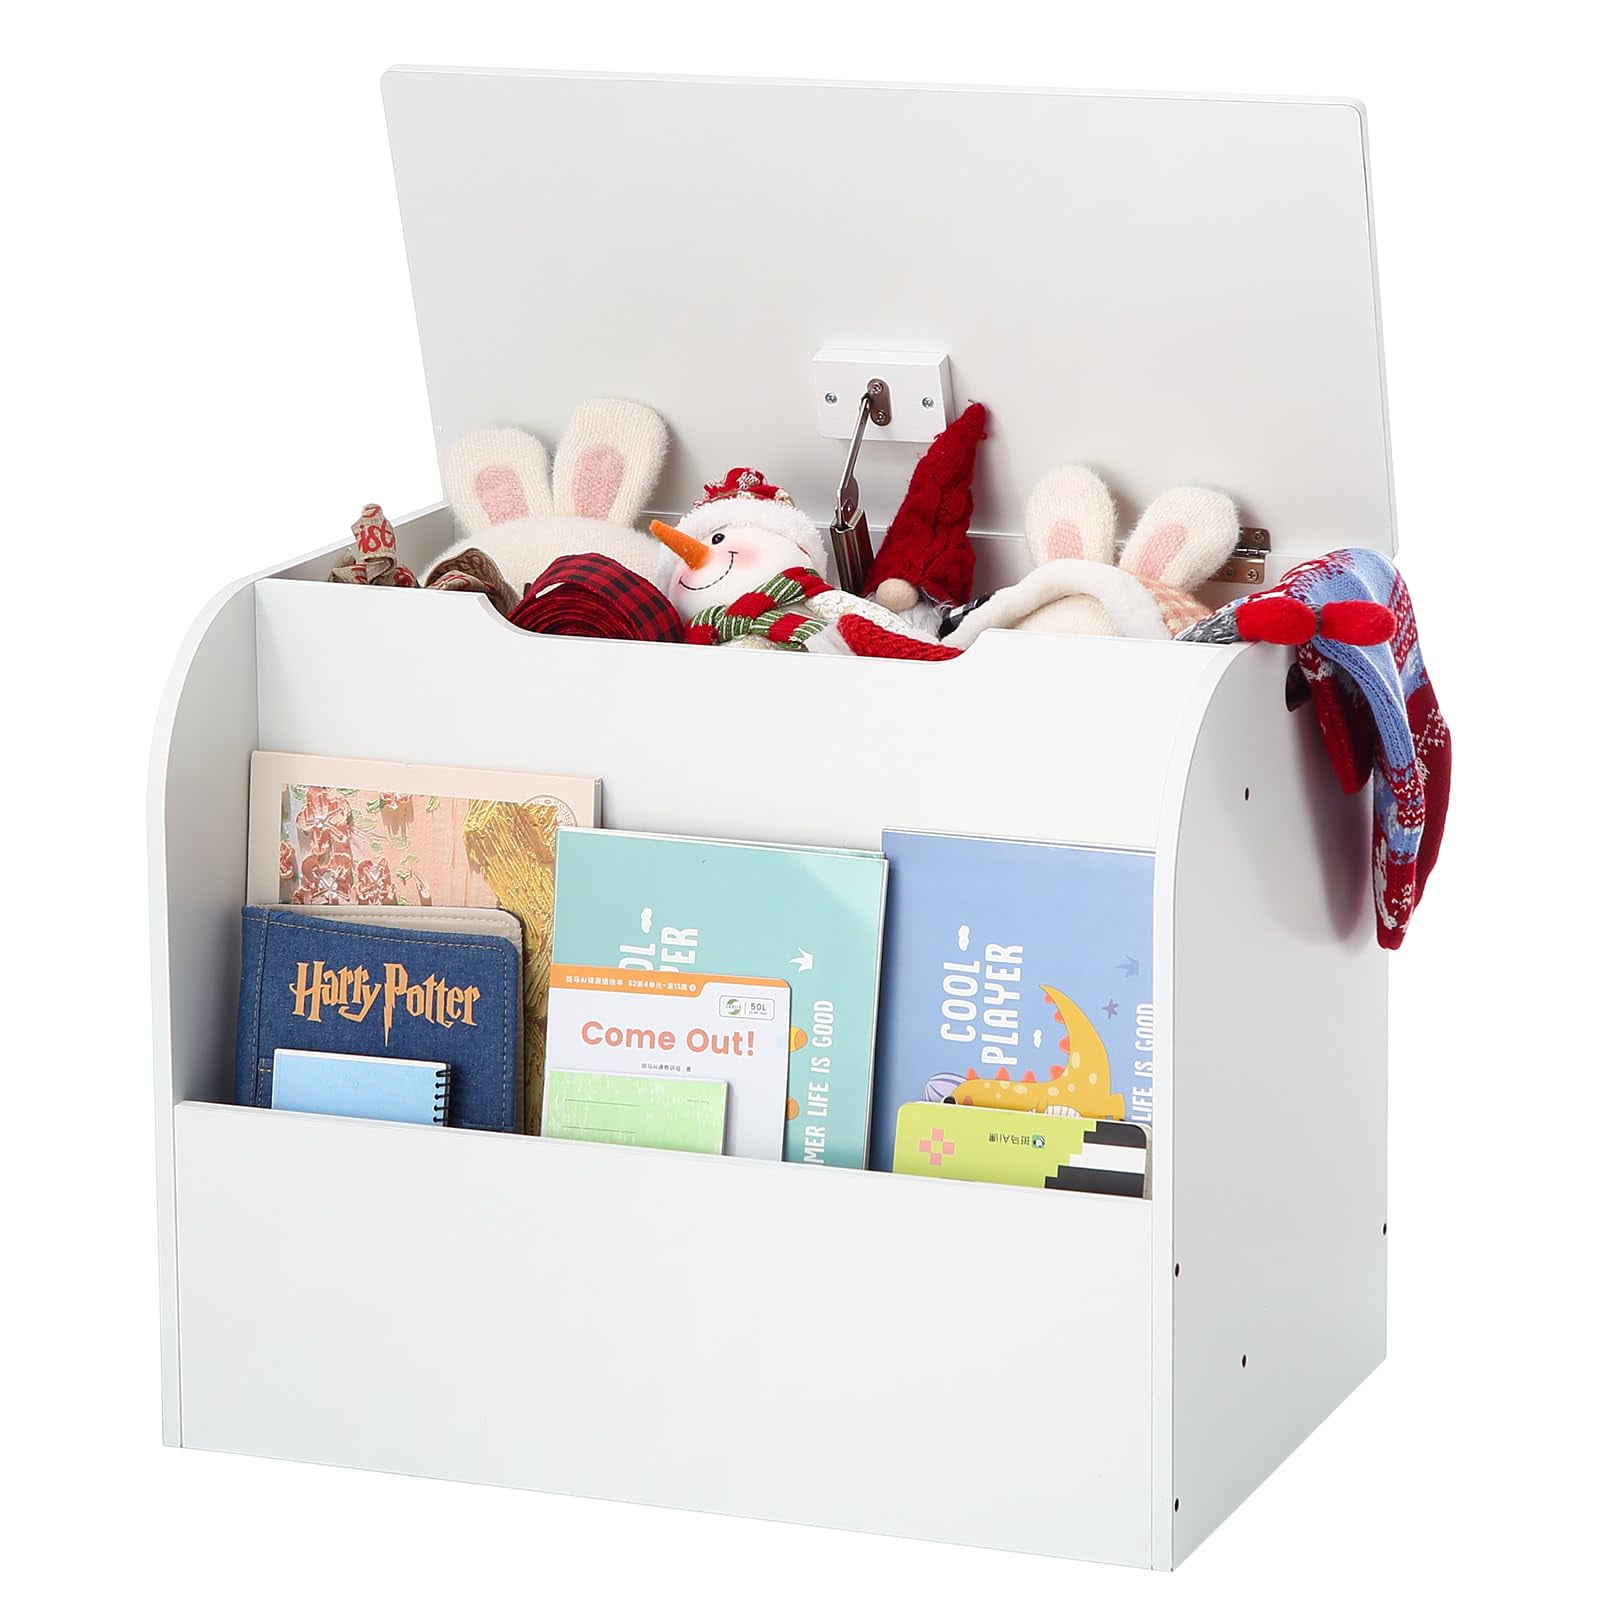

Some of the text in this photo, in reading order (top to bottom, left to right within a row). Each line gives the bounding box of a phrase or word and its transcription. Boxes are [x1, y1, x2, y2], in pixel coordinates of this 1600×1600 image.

[289, 960, 481, 1047] Harry Potter
[812, 1000, 834, 1048] GOOD
[940, 960, 980, 1042] COOL
[981, 943, 1023, 1065] PLAYER
[581, 1020, 754, 1057] Come Out!
[810, 1056, 831, 1073] IS
[1131, 1003, 1153, 1122] LIFE IS GOOD
[807, 1082, 829, 1117] LIFE
